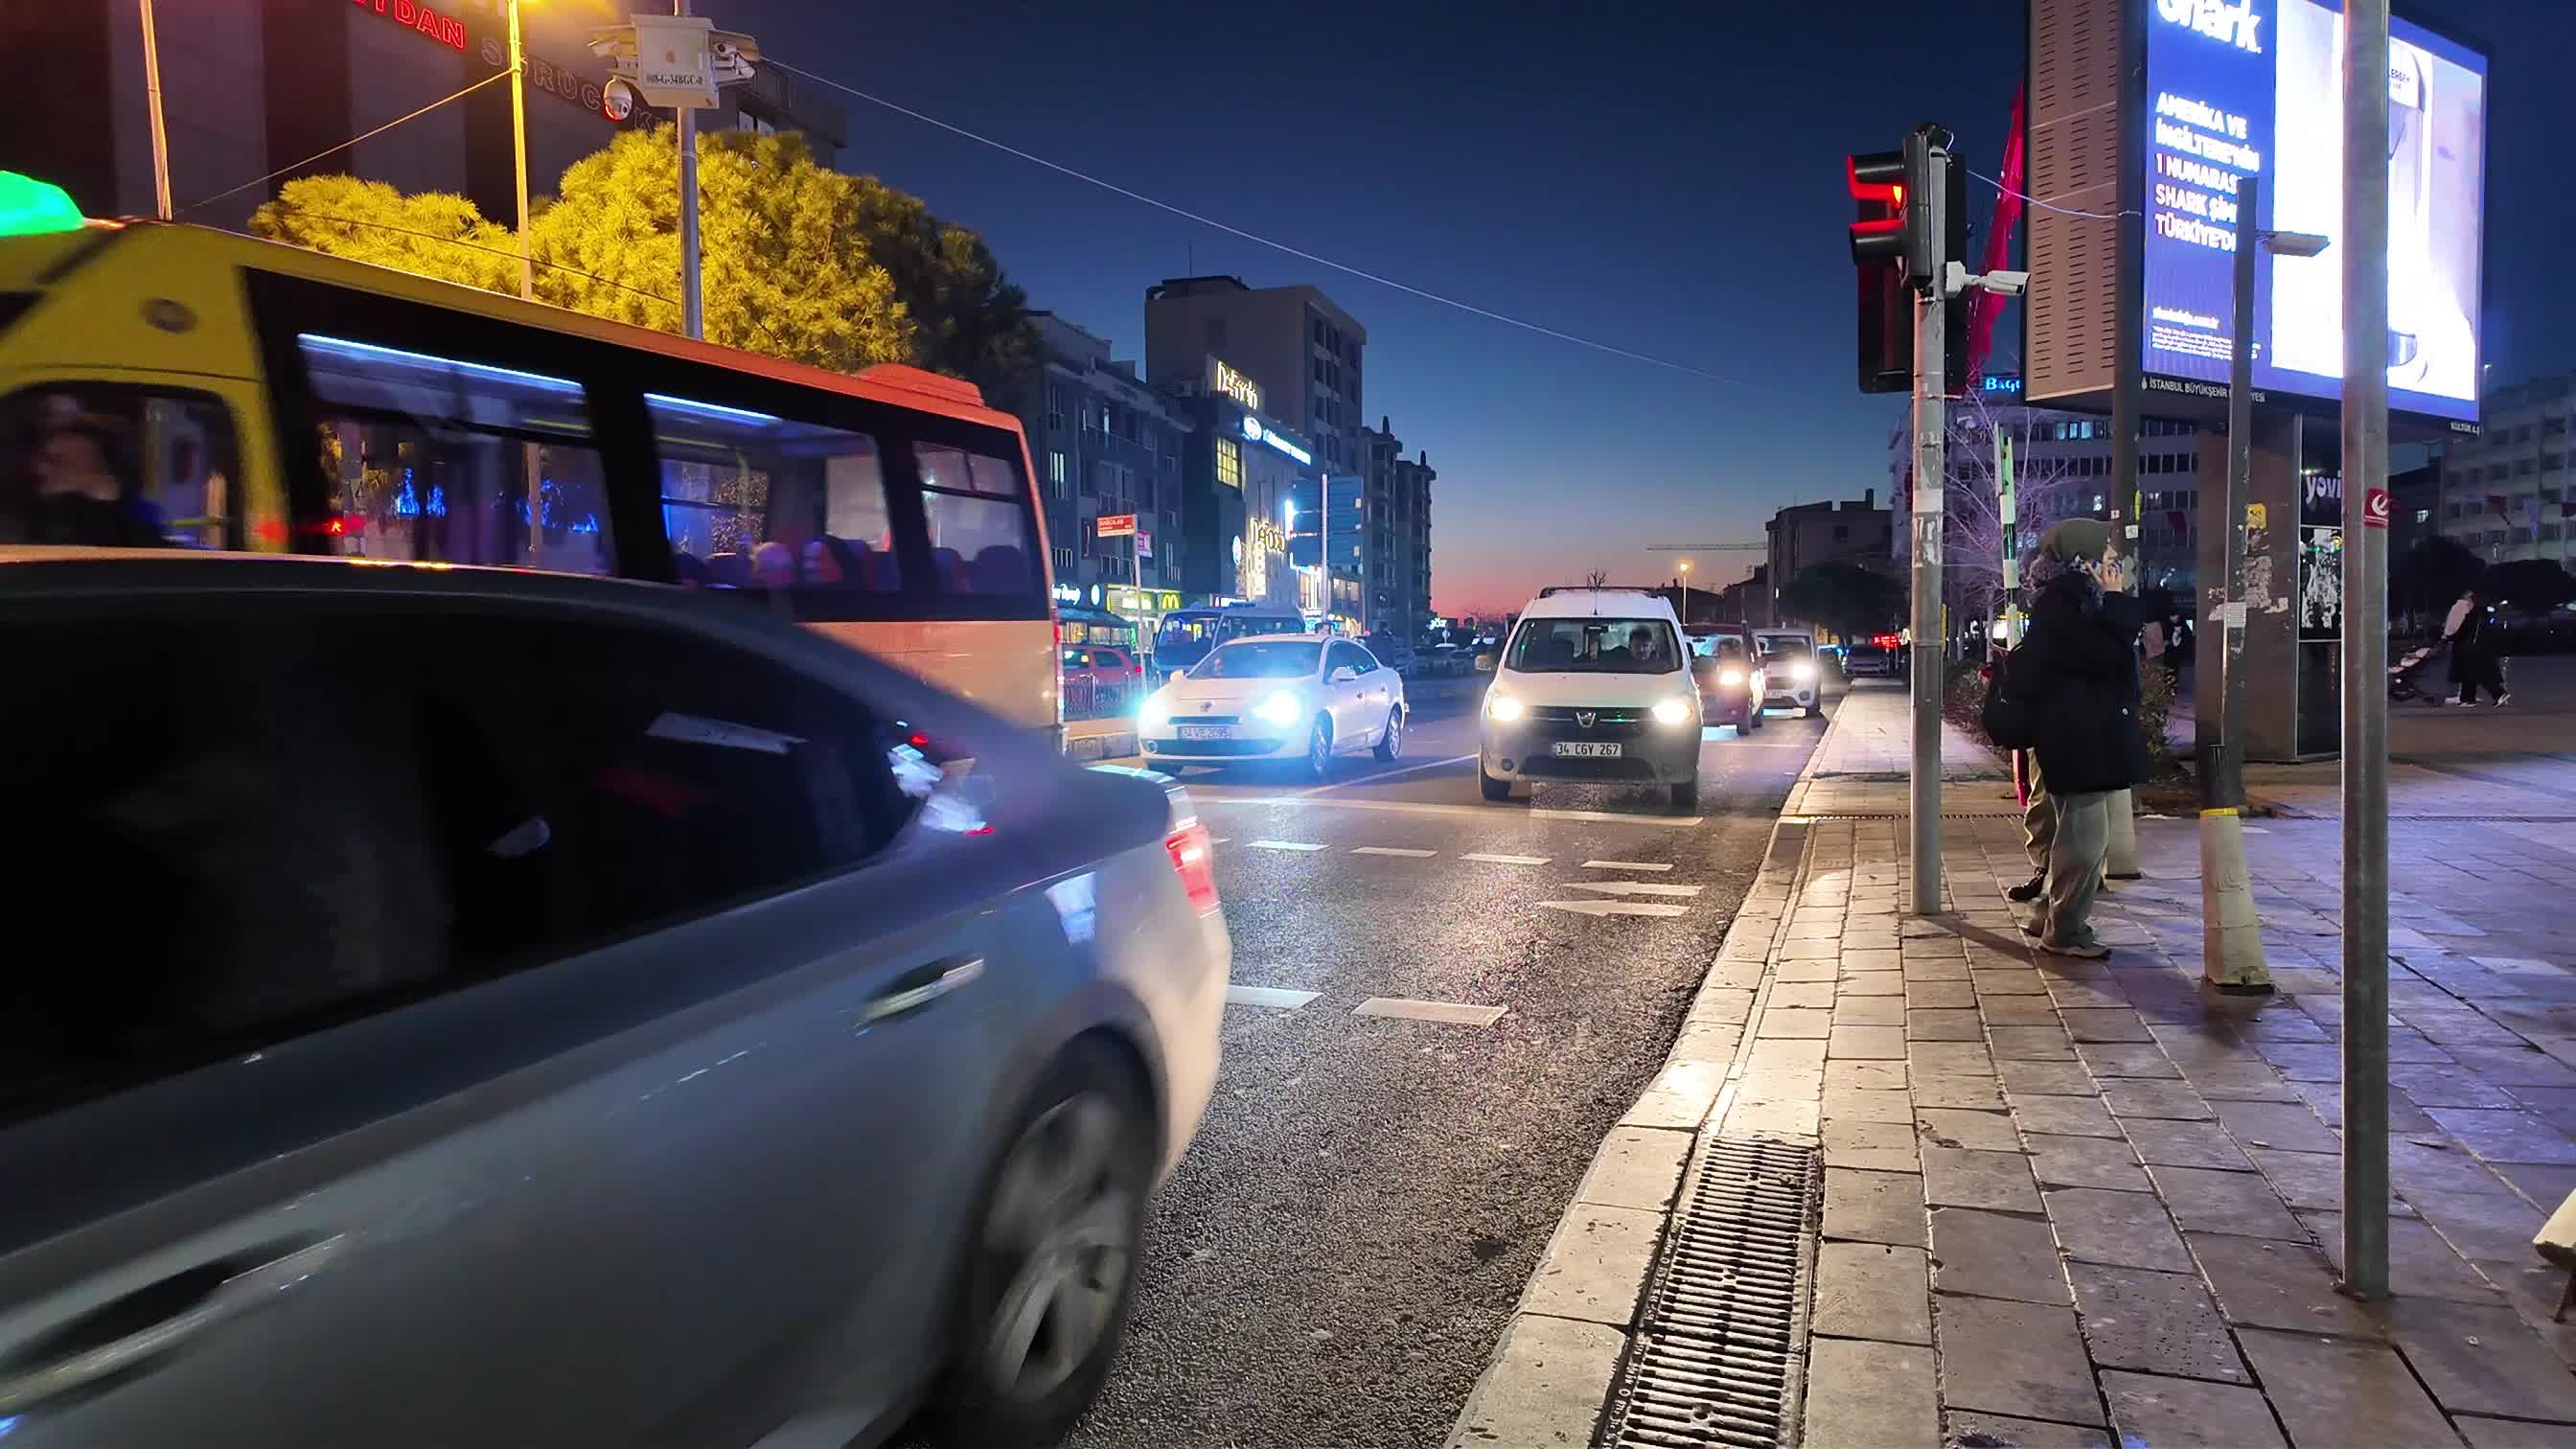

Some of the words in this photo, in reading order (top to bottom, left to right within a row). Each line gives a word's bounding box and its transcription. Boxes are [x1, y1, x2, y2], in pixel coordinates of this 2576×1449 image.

[2226, 113, 2247, 140] VE
[2155, 153, 2164, 173] 1
[2166, 155, 2243, 195] NUMARAS
[2155, 183, 2208, 217] SHARK
[2150, 377, 2184, 393] İSTANBUL
[1557, 743, 1570, 755] 34
[1575, 744, 1595, 755] CGY
[1599, 744, 1620, 756] 267
